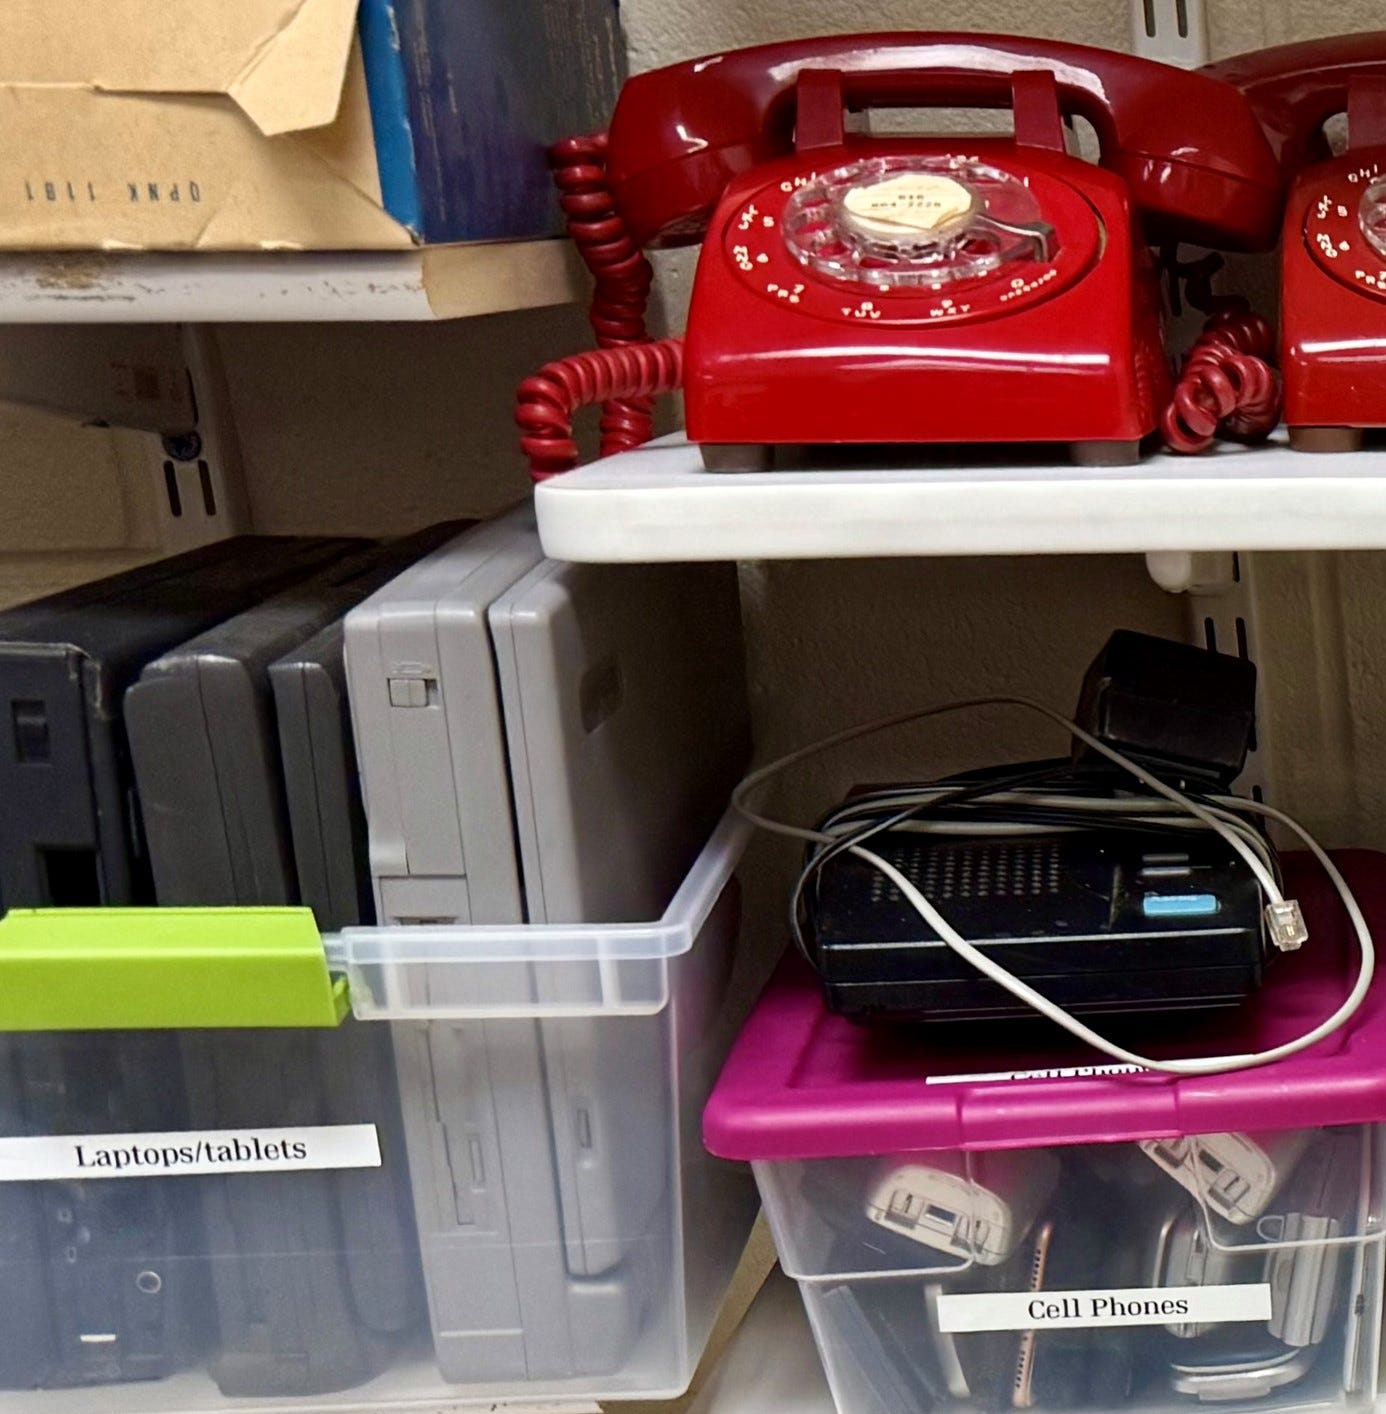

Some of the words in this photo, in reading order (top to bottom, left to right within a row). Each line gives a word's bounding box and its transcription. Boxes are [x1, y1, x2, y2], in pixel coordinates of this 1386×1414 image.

[74, 1136, 308, 1170] Laptops/tablets
[1028, 1298, 1083, 1320] Cell
[1091, 1296, 1189, 1317] Phones
